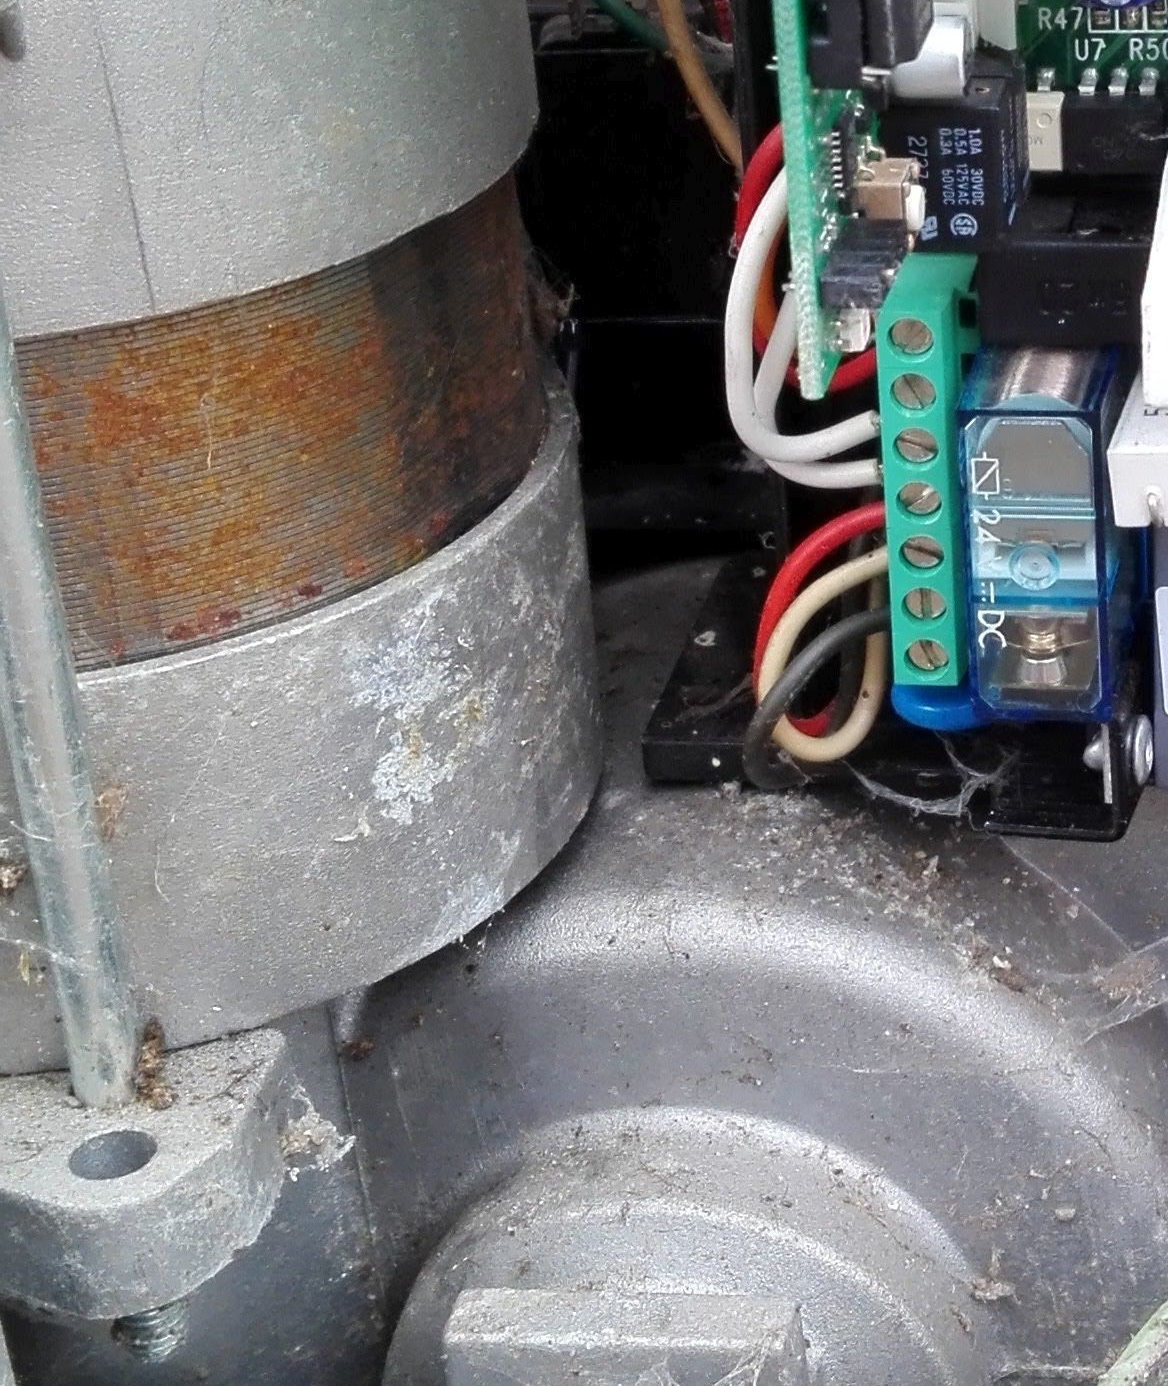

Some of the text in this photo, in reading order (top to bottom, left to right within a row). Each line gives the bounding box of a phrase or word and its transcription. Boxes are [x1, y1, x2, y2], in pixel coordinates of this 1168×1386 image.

[1038, 7, 1083, 31] R47
[1074, 38, 1105, 61] U7
[977, 610, 1008, 649] DC
